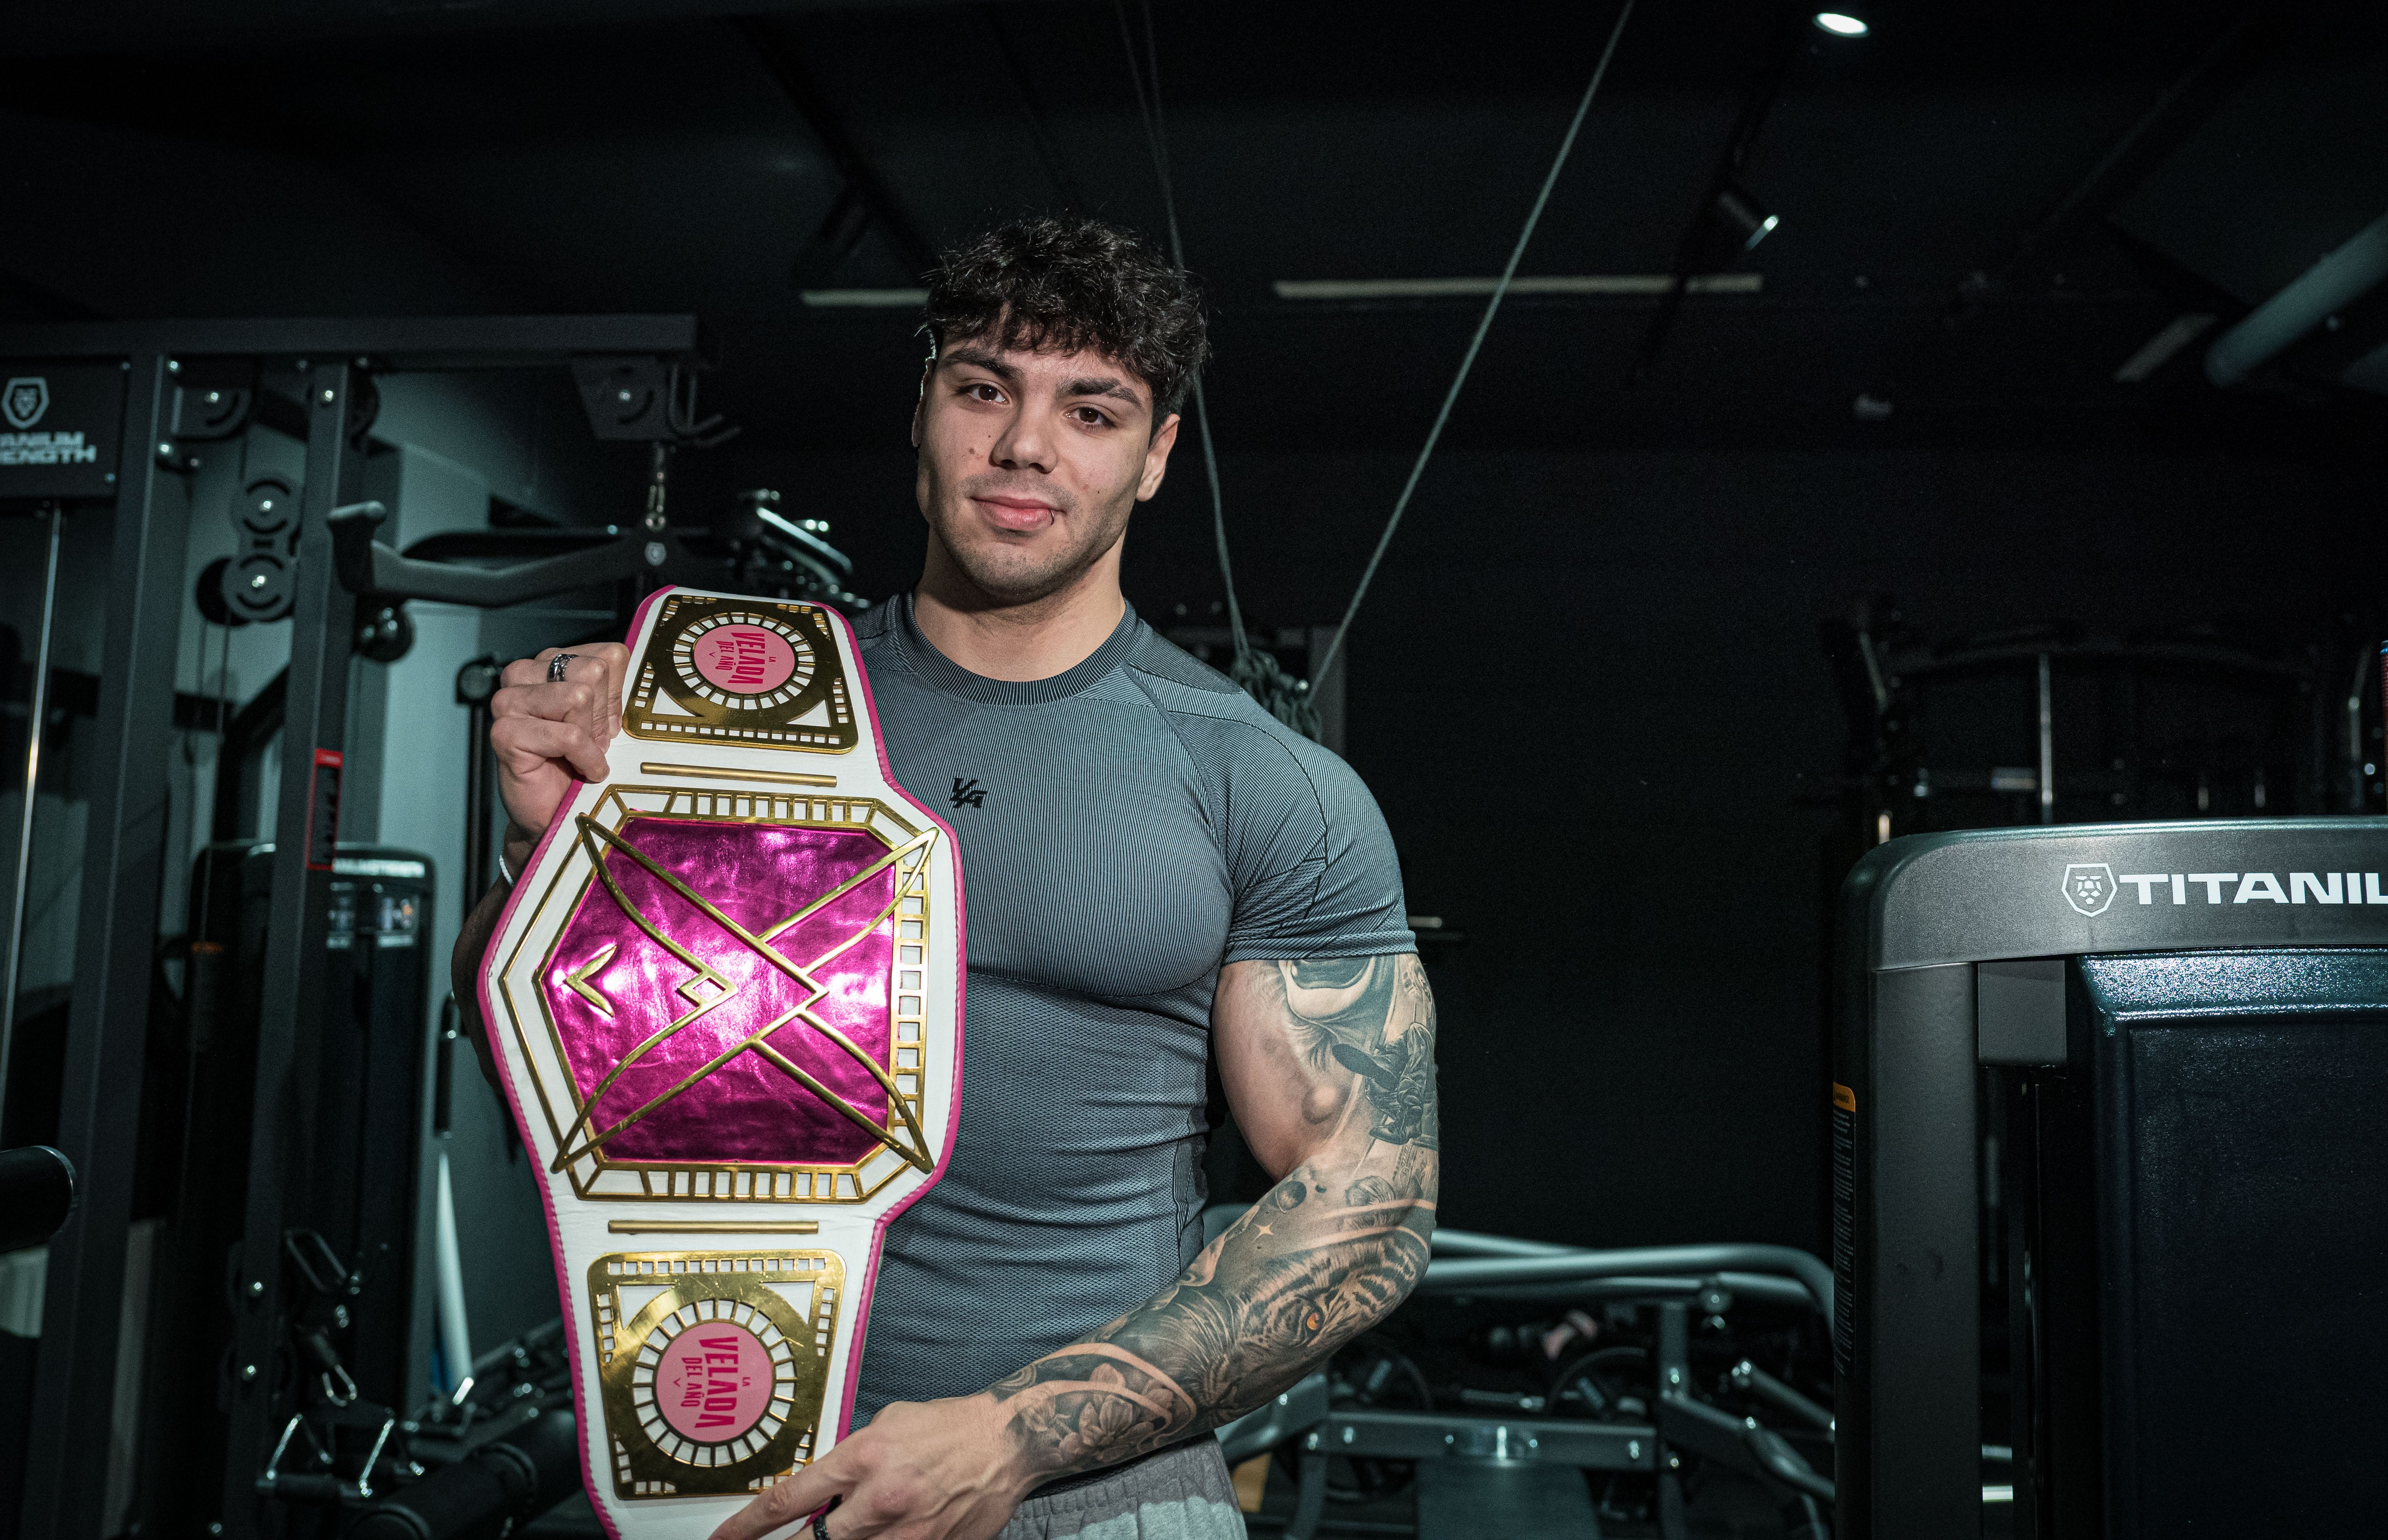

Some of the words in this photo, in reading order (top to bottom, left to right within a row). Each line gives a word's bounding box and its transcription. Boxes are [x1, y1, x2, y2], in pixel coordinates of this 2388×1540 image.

[716, 640, 735, 653] DEL
[715, 655, 736, 671] AÑO
[727, 632, 766, 684] VELADA
[682, 1357, 703, 1377] DEL
[694, 1336, 739, 1429] VELADA
[742, 1377, 751, 1387] LA
[680, 1383, 705, 1408] AÑO
